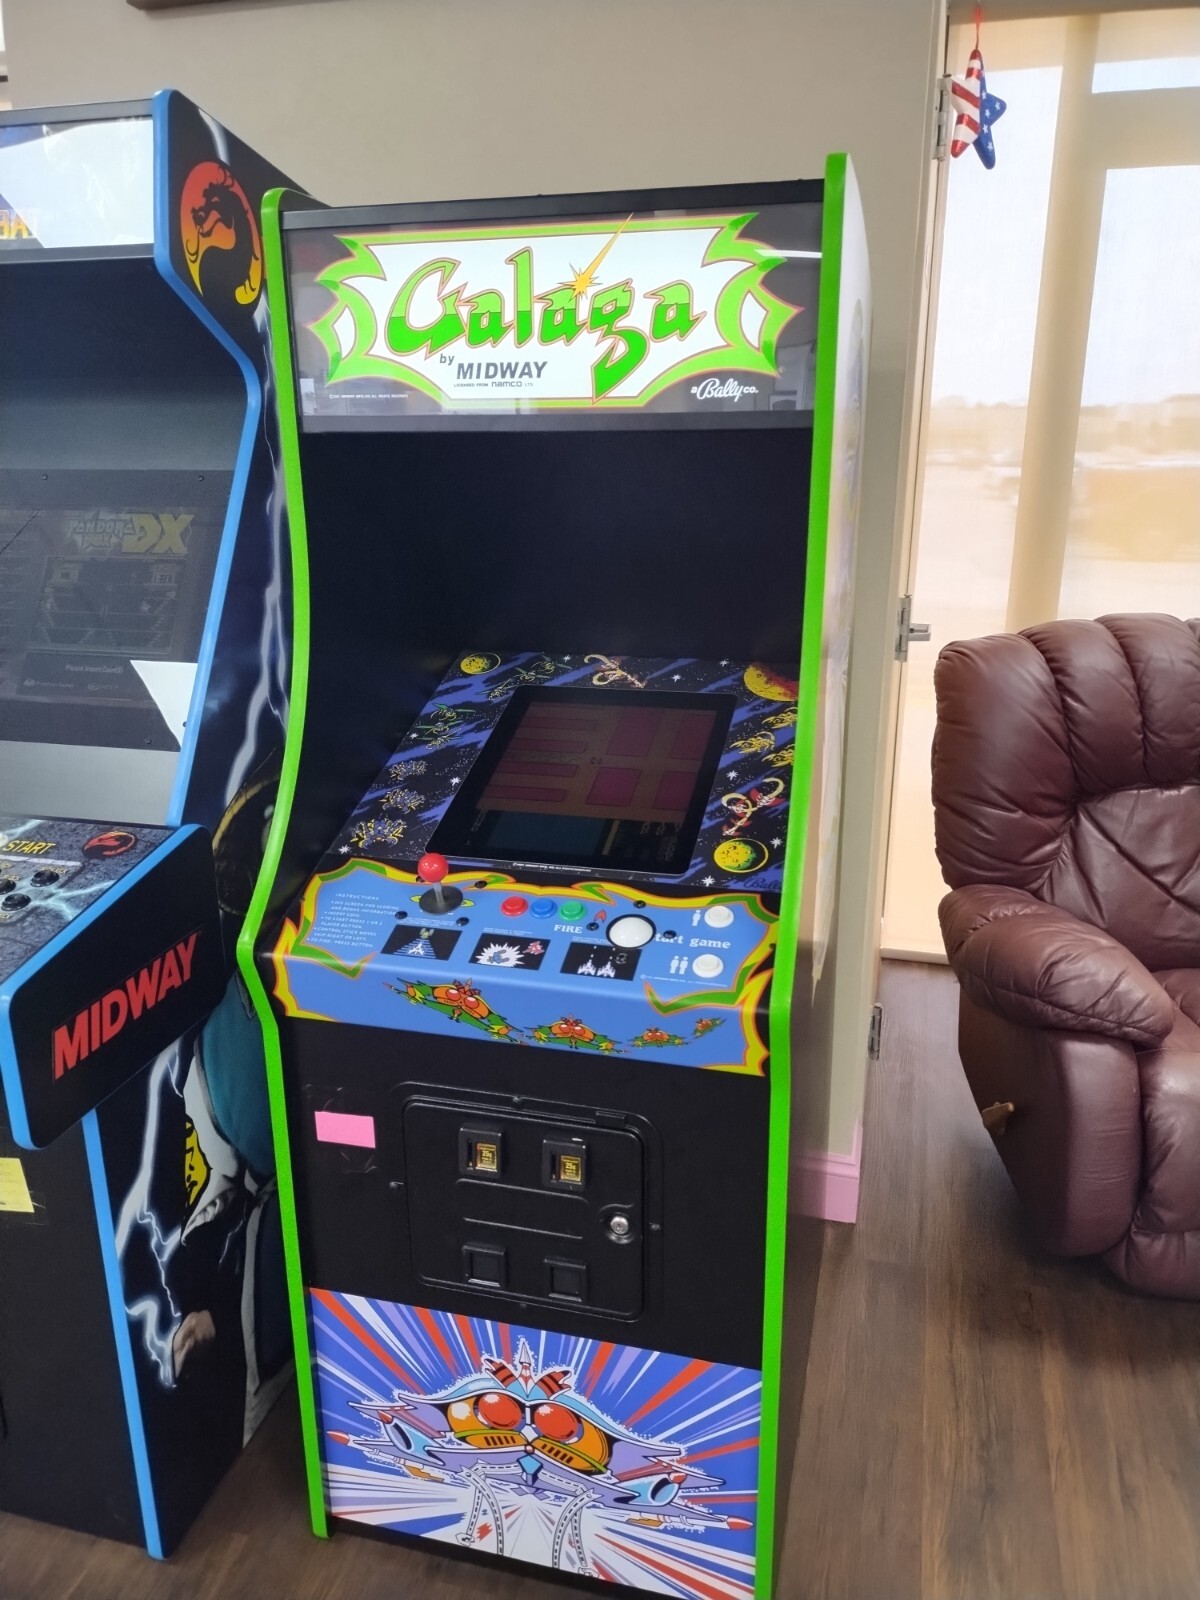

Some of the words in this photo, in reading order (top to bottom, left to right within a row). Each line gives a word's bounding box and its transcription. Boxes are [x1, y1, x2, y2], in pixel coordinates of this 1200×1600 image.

[385, 246, 707, 405] Galaga
[439, 353, 455, 366] by
[456, 361, 548, 380] MIDWAY
[491, 380, 523, 388] namco
[690, 386, 698, 394] a
[696, 377, 744, 403] Bally
[121, 513, 195, 554] DX
[2, 840, 57, 855] START
[335, 893, 380, 901] INSTRUCTIONS
[553, 924, 584, 934] FIRE
[654, 932, 684, 944] tart
[689, 937, 731, 949] game
[53, 932, 199, 1081] MIDWAY
